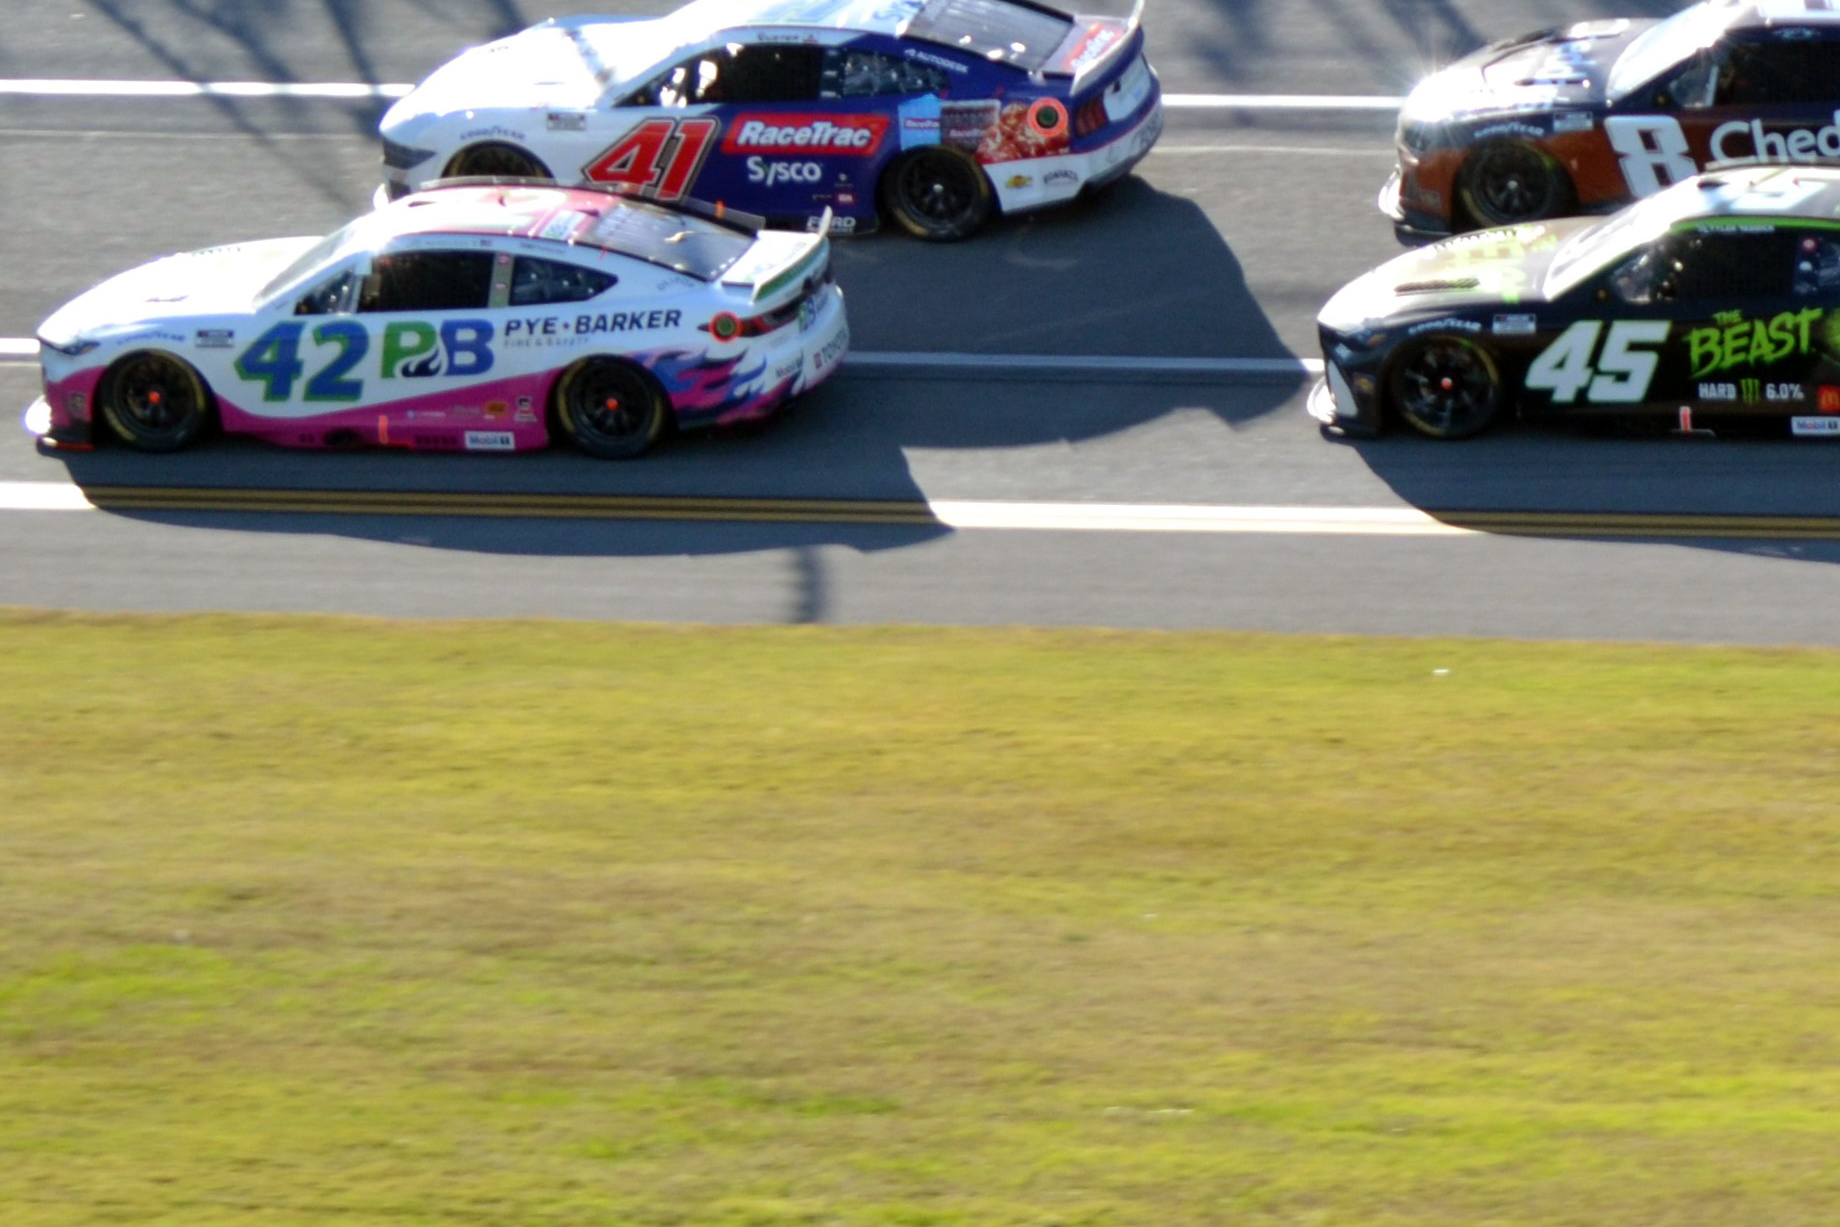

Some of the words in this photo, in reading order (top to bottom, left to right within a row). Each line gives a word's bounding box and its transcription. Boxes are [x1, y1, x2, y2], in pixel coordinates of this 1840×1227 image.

[917, 51, 969, 73] AUTODESK
[736, 120, 873, 147] RaceTrac
[580, 115, 721, 203] 41
[745, 155, 822, 187] Sysco
[1603, 115, 1702, 199] 8
[807, 215, 857, 229] FRD
[504, 316, 558, 337] PYE
[575, 309, 682, 335] BARKER
[1711, 308, 1743, 325] THE
[1682, 306, 1824, 378] BEAST
[233, 319, 371, 403] 42
[1524, 320, 1673, 403] 45
[1698, 383, 1737, 399] HARD
[1765, 382, 1805, 399] 6.0%
